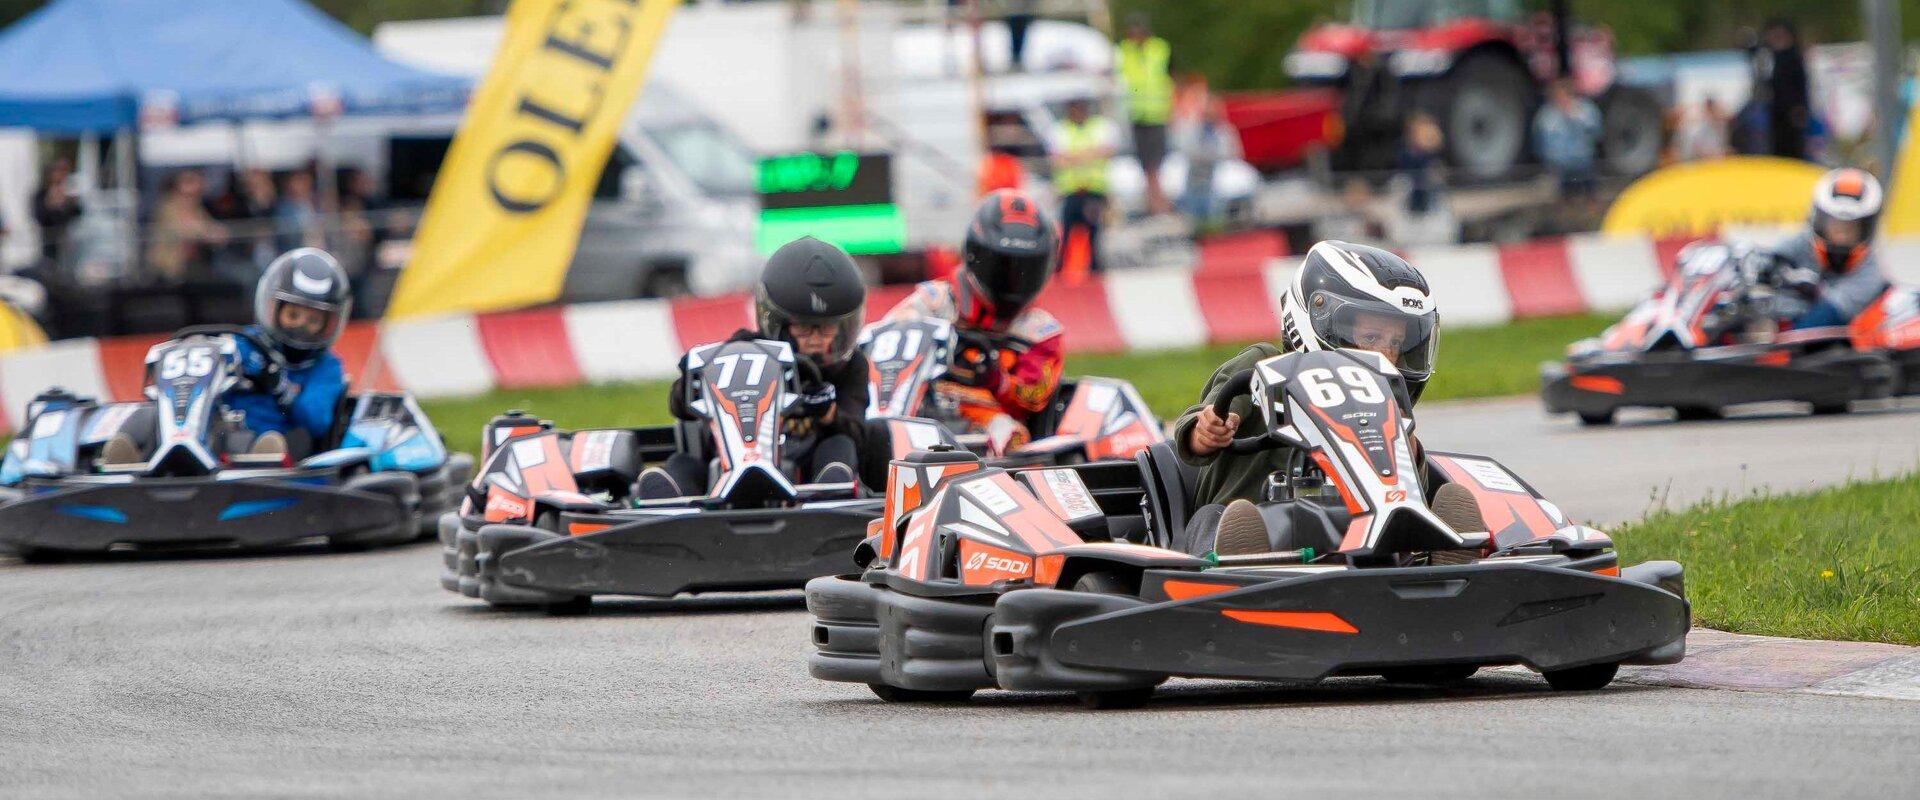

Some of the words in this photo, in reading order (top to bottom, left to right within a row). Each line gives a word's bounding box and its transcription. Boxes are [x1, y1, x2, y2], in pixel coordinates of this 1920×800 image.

[486, 0, 640, 215] OLE
[871, 329, 923, 363] 81
[161, 347, 214, 380] 55
[713, 353, 769, 389] 77
[1297, 365, 1386, 408] 69
[1341, 411, 1378, 420] SODI
[984, 556, 1030, 575] SODI
